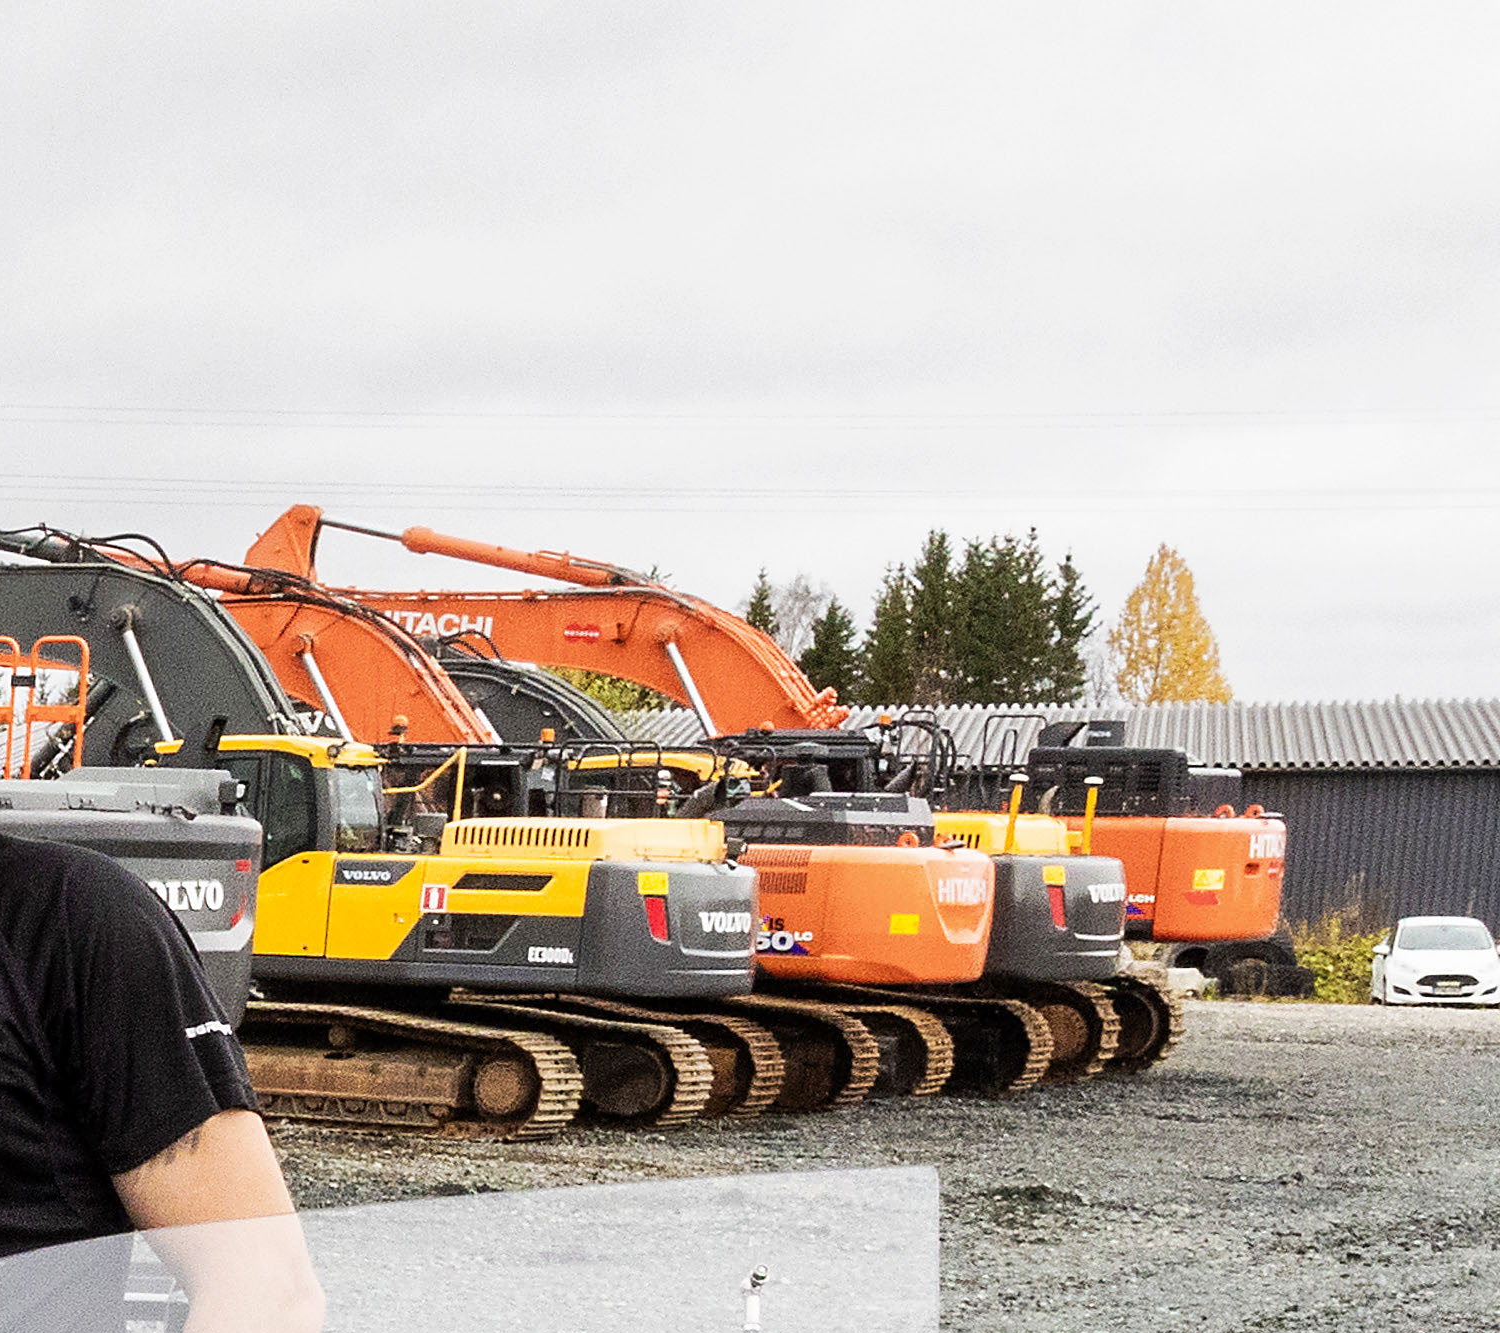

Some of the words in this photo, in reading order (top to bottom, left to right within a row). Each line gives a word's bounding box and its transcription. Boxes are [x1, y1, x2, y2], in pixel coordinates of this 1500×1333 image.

[342, 868, 392, 883] VOLVO
[937, 878, 987, 904] HITACHI
[700, 911, 752, 934] VOLVO
